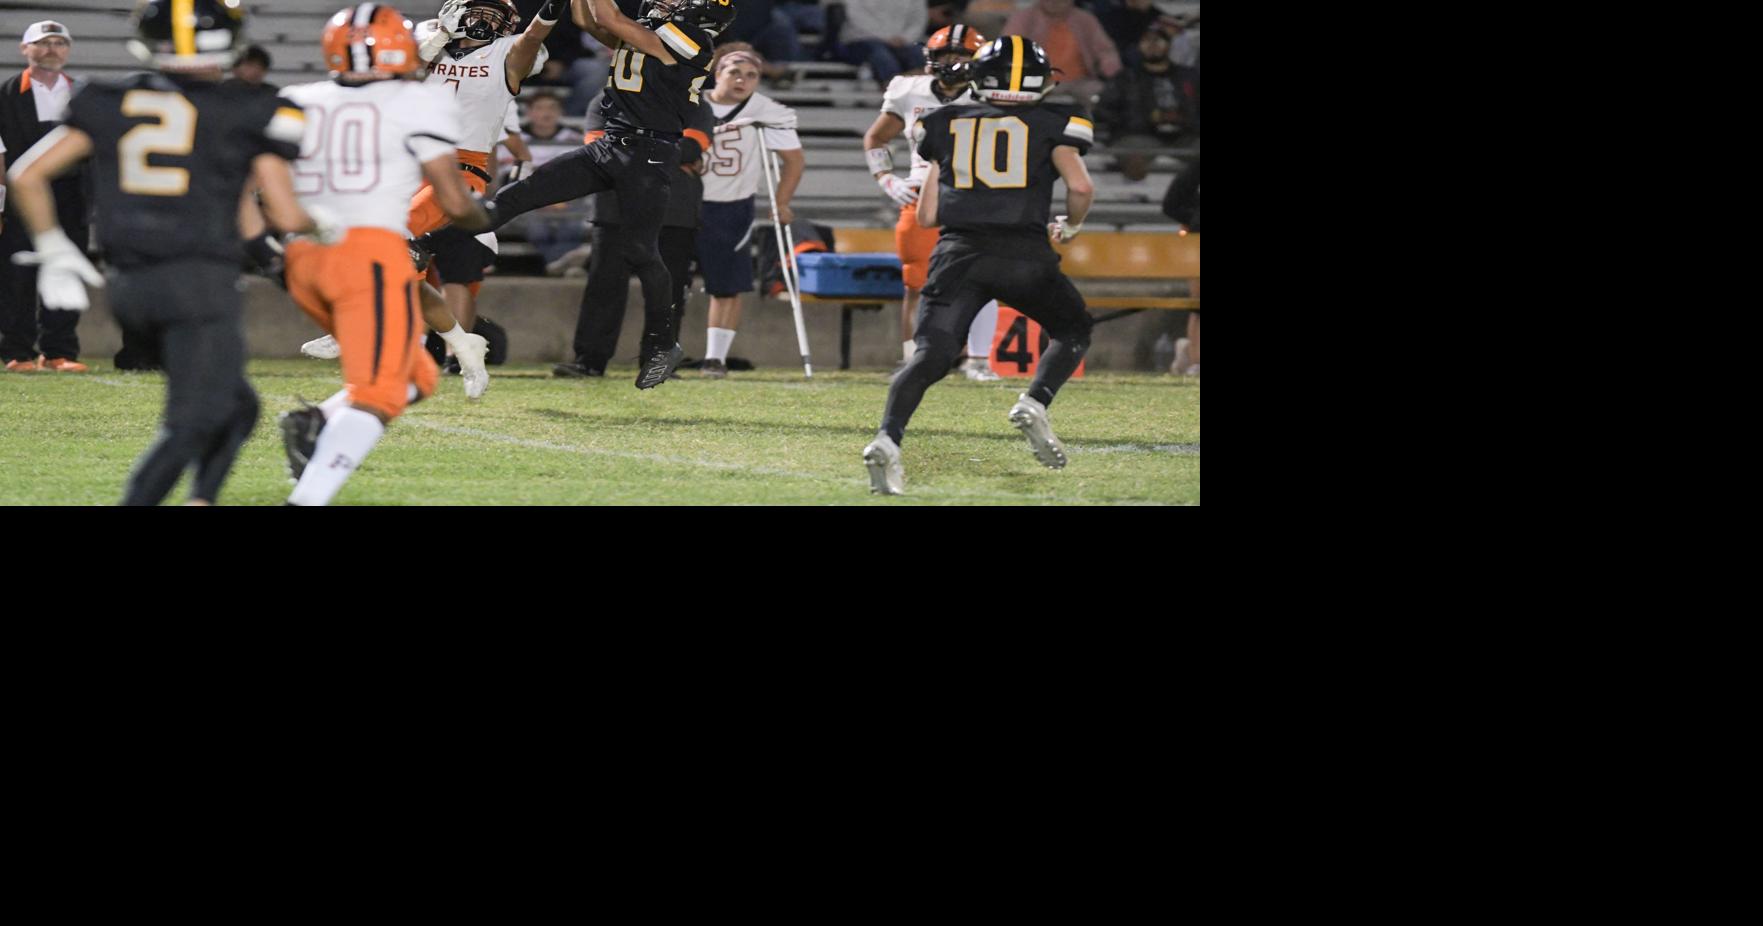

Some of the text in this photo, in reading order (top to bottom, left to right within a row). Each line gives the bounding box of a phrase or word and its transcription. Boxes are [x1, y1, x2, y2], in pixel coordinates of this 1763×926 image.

[118, 90, 198, 196] 2
[950, 116, 1030, 189] 10
[995, 315, 1051, 374] 4
